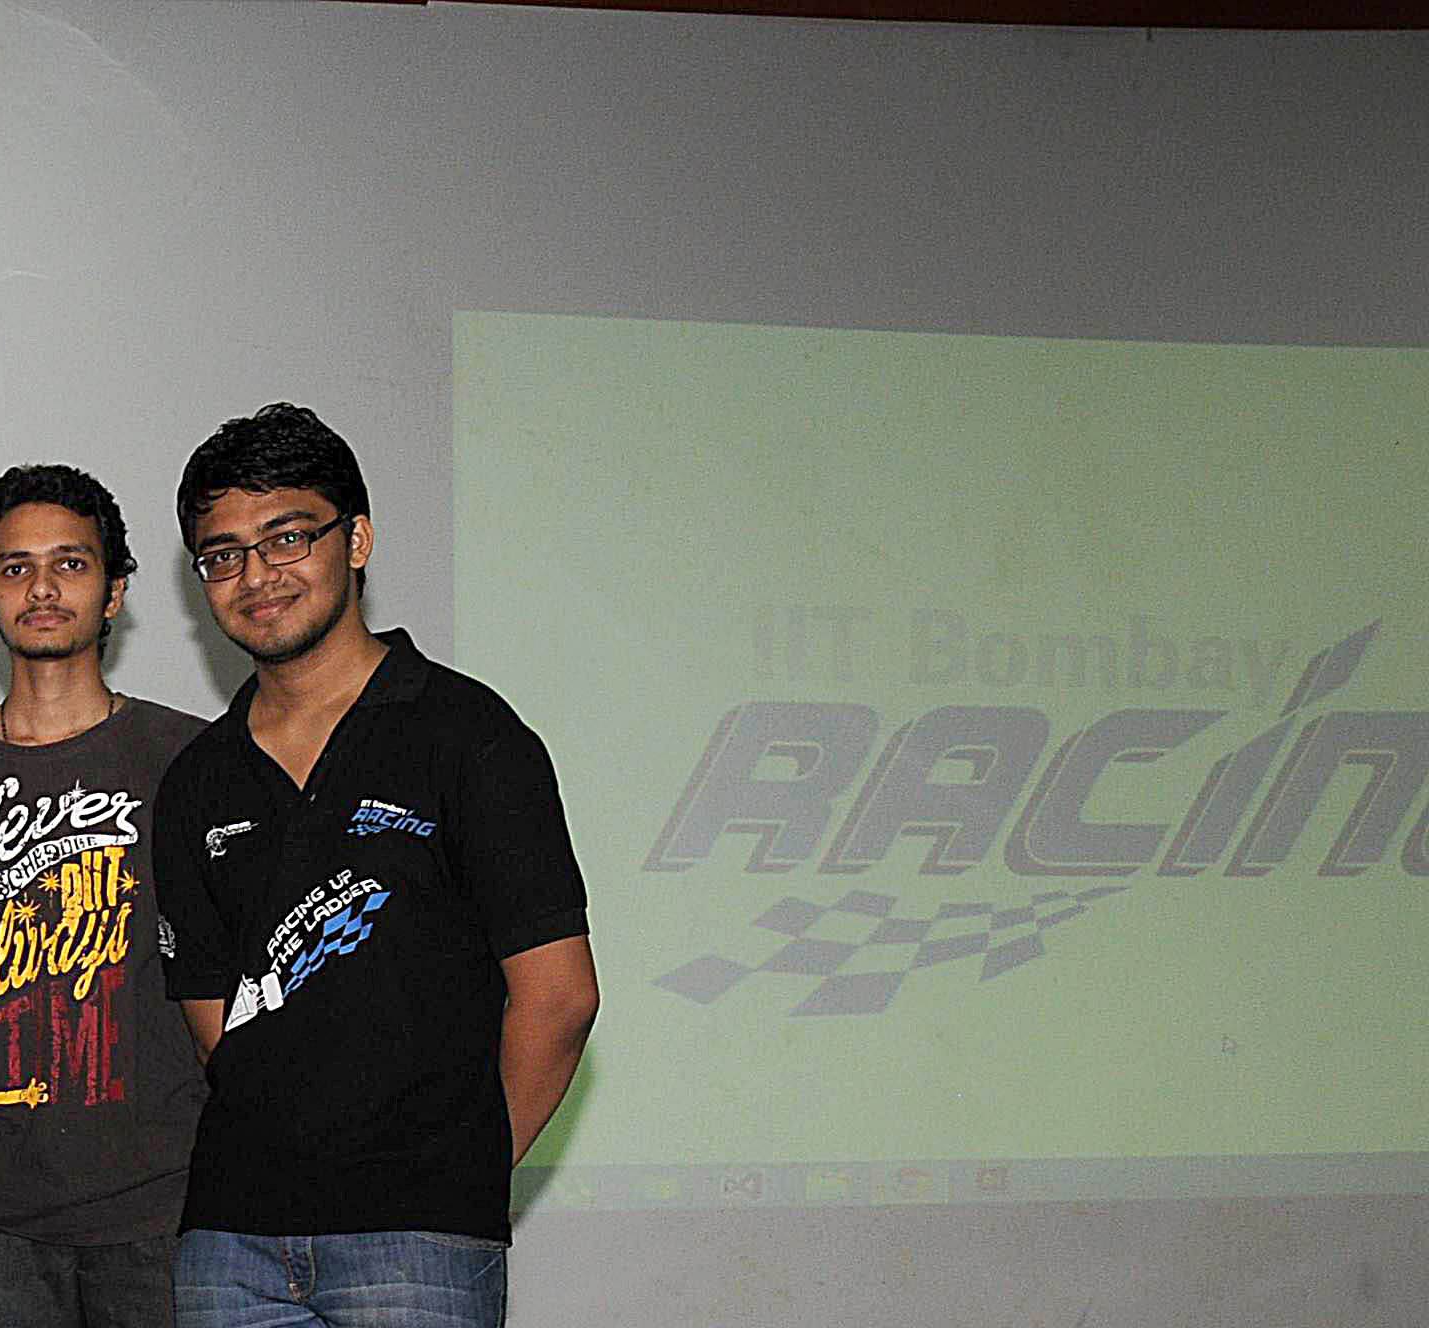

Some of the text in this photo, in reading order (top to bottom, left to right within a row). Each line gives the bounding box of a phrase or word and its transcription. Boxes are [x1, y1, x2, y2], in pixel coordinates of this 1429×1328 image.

[909, 605, 1287, 706] Bombay
[267, 870, 352, 958] RACING UP
[270, 879, 382, 975] THE LADDER
